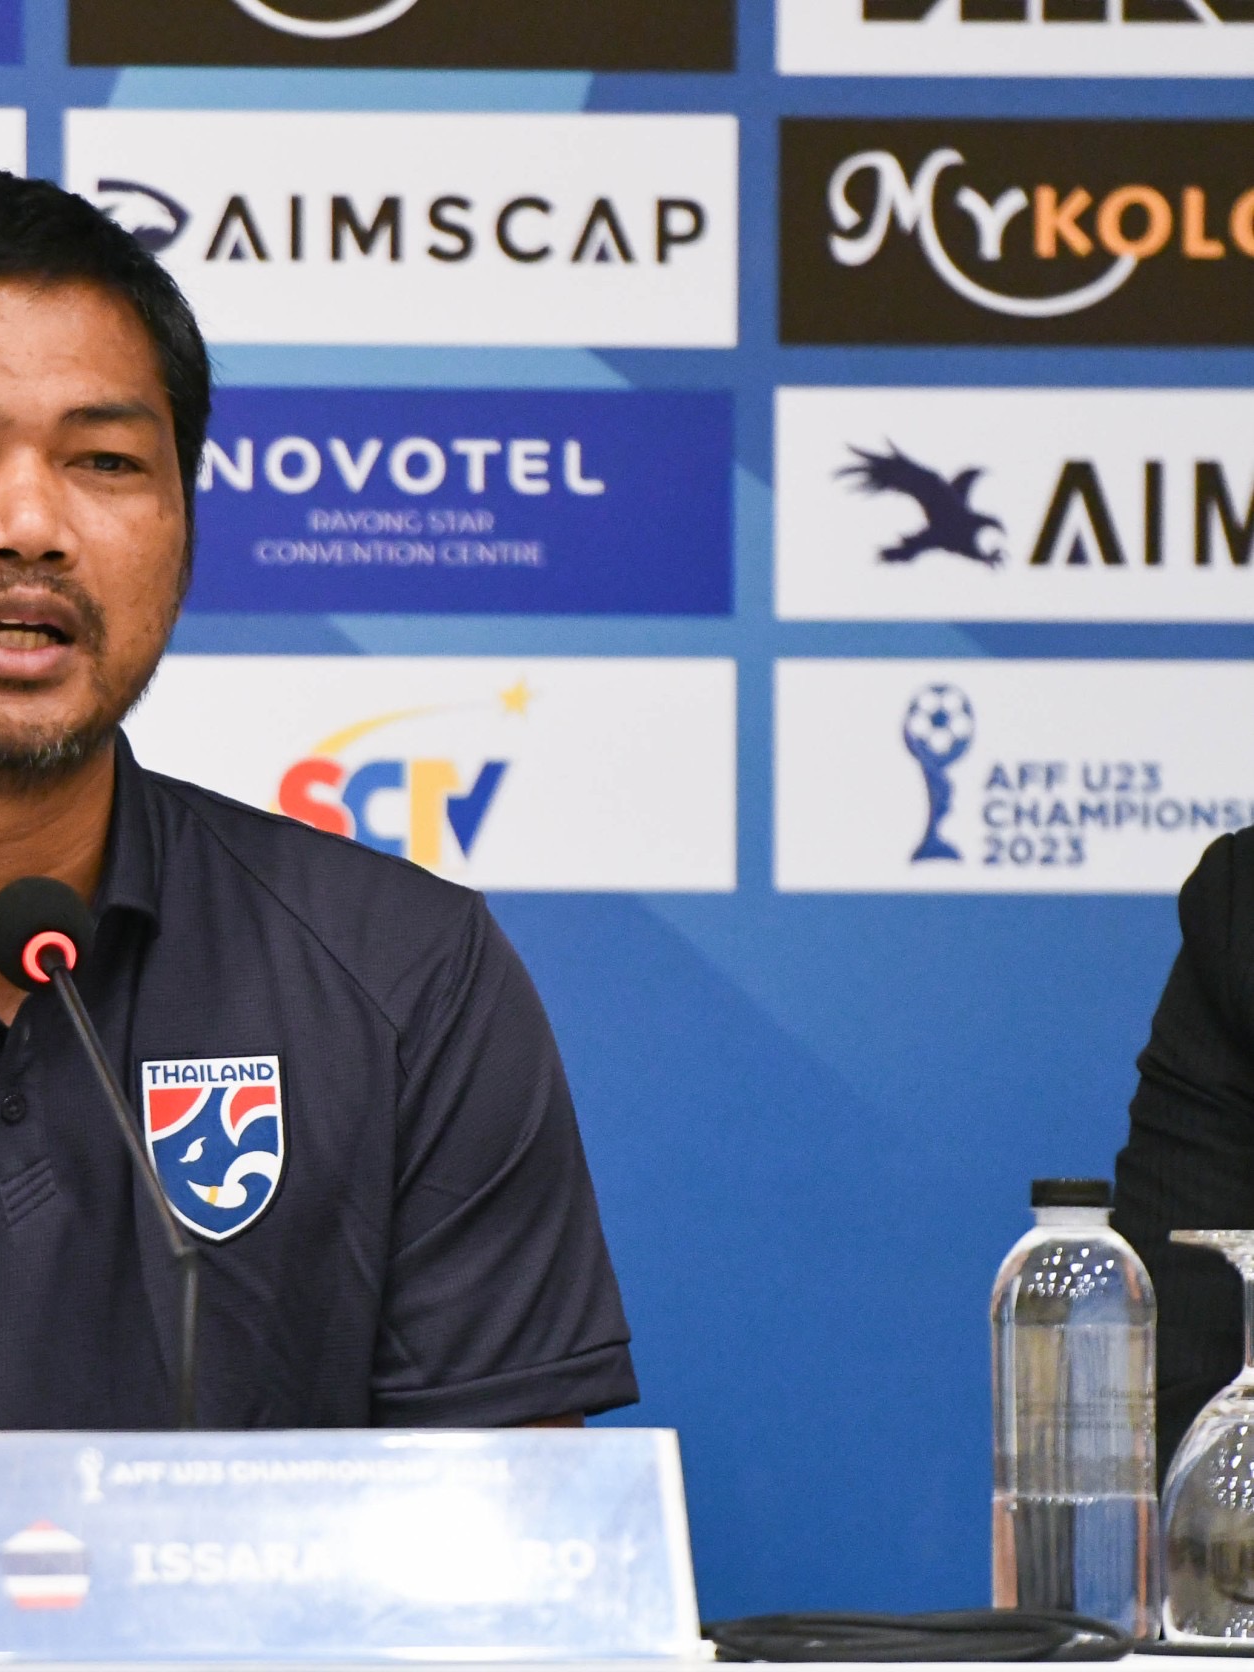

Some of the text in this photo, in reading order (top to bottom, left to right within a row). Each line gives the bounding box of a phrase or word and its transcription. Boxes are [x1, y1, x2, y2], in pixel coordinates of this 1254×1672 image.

[204, 195, 707, 264] AIMSCAP
[198, 437, 605, 494] NOVOTEL
[311, 510, 495, 535] RAYONG STAR
[258, 540, 544, 567] CONVENTION CENTRE
[985, 763, 1161, 792] AFF U23
[277, 757, 510, 868] SCTV
[984, 801, 1254, 829] CHAMPIONS
[984, 836, 1084, 864] 2023
[147, 1063, 275, 1084] THAILAND
